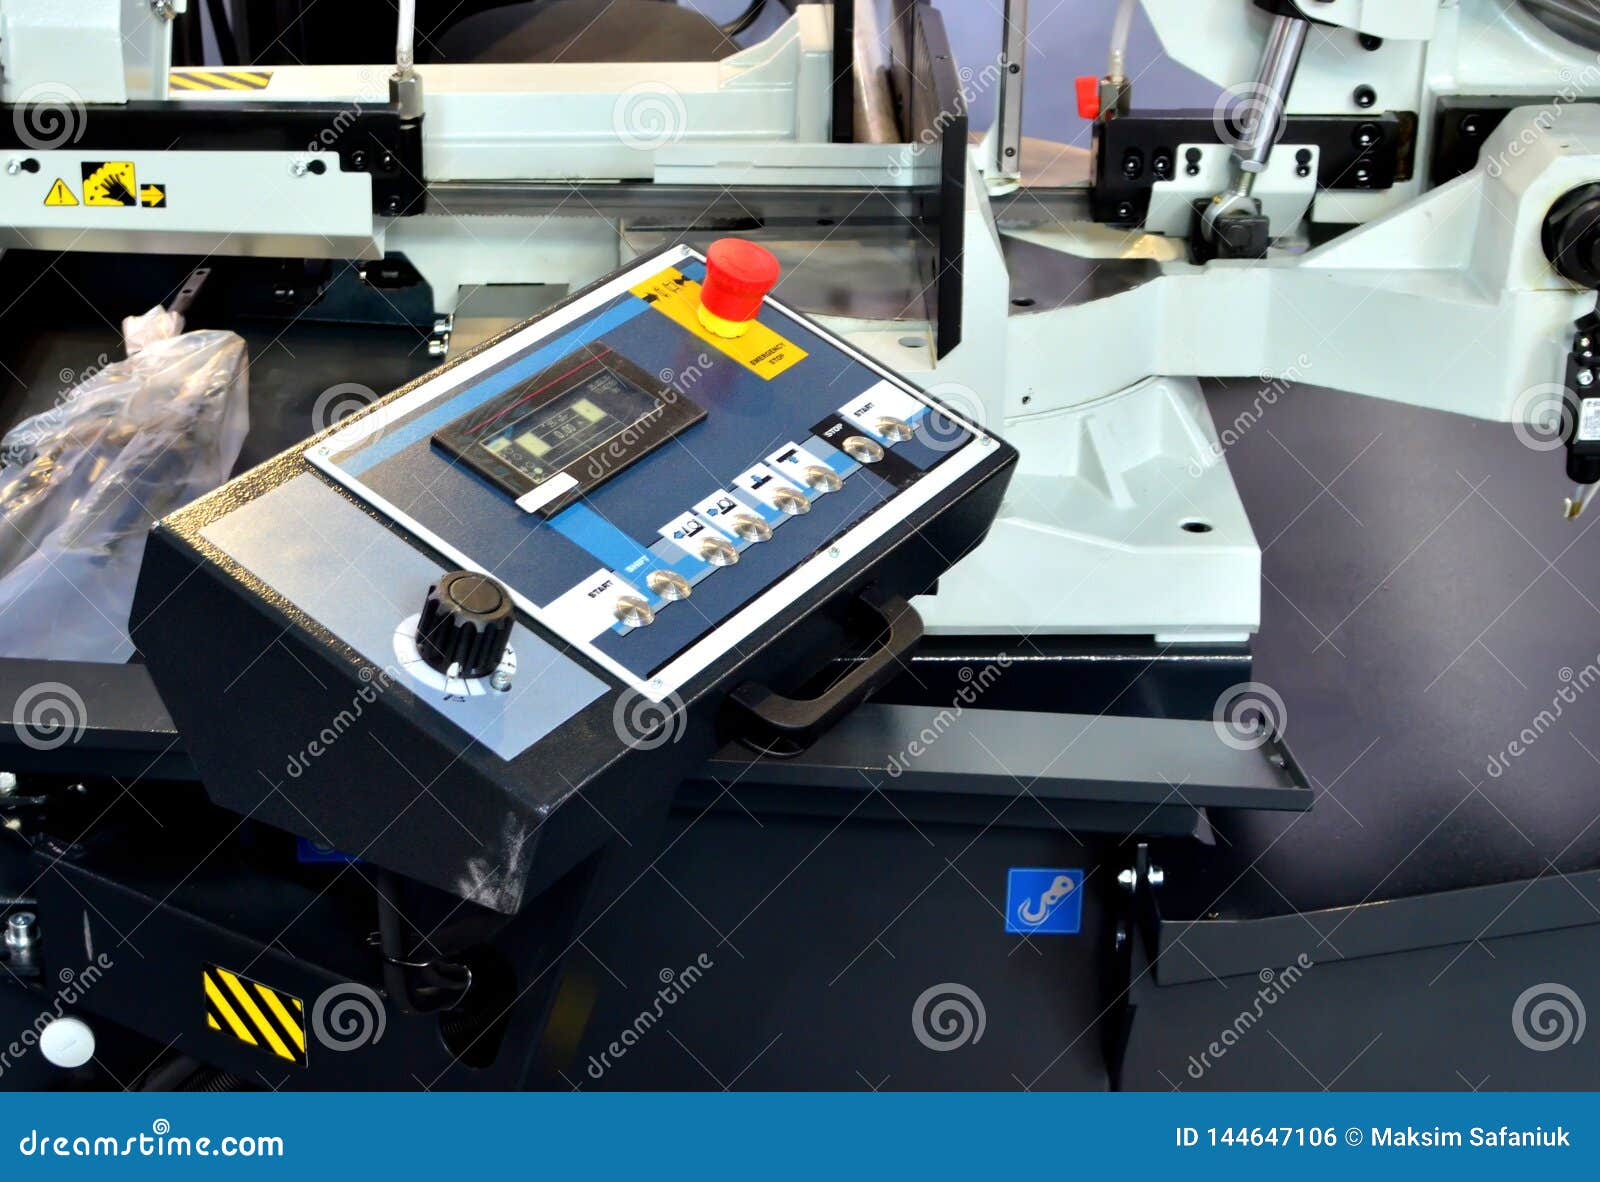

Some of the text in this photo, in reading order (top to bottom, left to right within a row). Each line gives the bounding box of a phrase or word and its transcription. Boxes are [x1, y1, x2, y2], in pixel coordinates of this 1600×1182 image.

[749, 342, 785, 366] EMERGENCY
[853, 402, 875, 417] START
[823, 423, 844, 438] STOP
[587, 579, 615, 599] START
